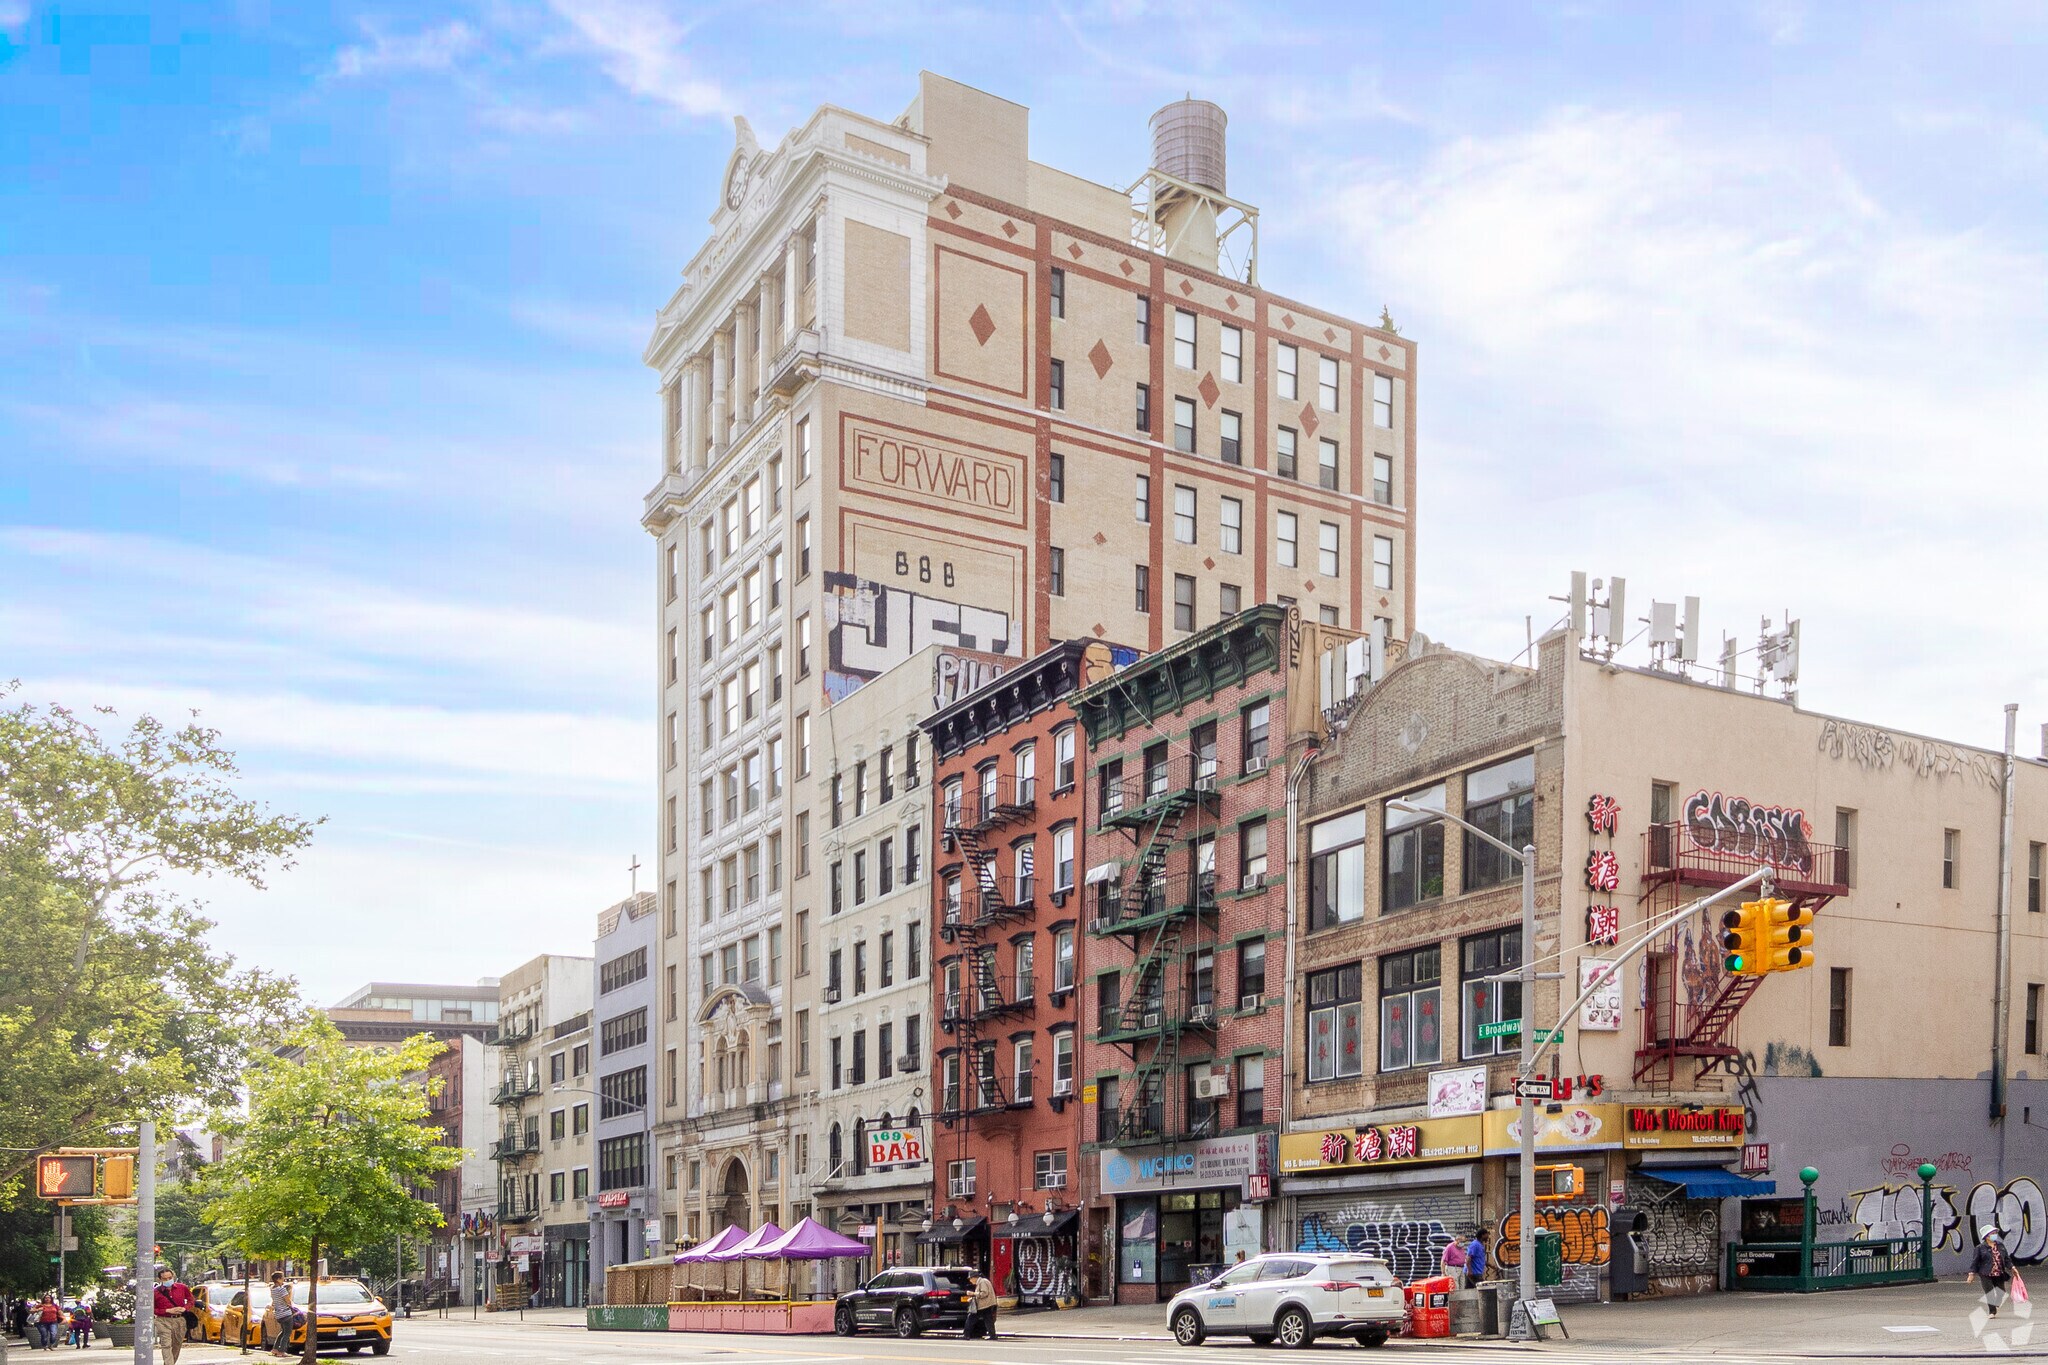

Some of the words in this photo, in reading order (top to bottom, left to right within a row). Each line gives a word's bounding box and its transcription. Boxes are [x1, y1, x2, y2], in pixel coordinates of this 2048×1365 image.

[857, 434, 1012, 509] FORWARD
[1479, 1026, 1483, 1037] E
[1485, 1021, 1521, 1034] Broadway
[1520, 1084, 1532, 1093] ONE
[1536, 1084, 1548, 1094] WAY
[1633, 1108, 1662, 1131] Wu's
[1666, 1108, 1715, 1131] Wonton
[1719, 1108, 1745, 1136] King
[872, 1131, 902, 1143] 169
[872, 1141, 921, 1163] BAR
[1743, 1146, 1760, 1170] ATM
[1298, 1158, 1321, 1168] Broadway
[1849, 1248, 1874, 1257] Subway
[1740, 1266, 1746, 1274] F
